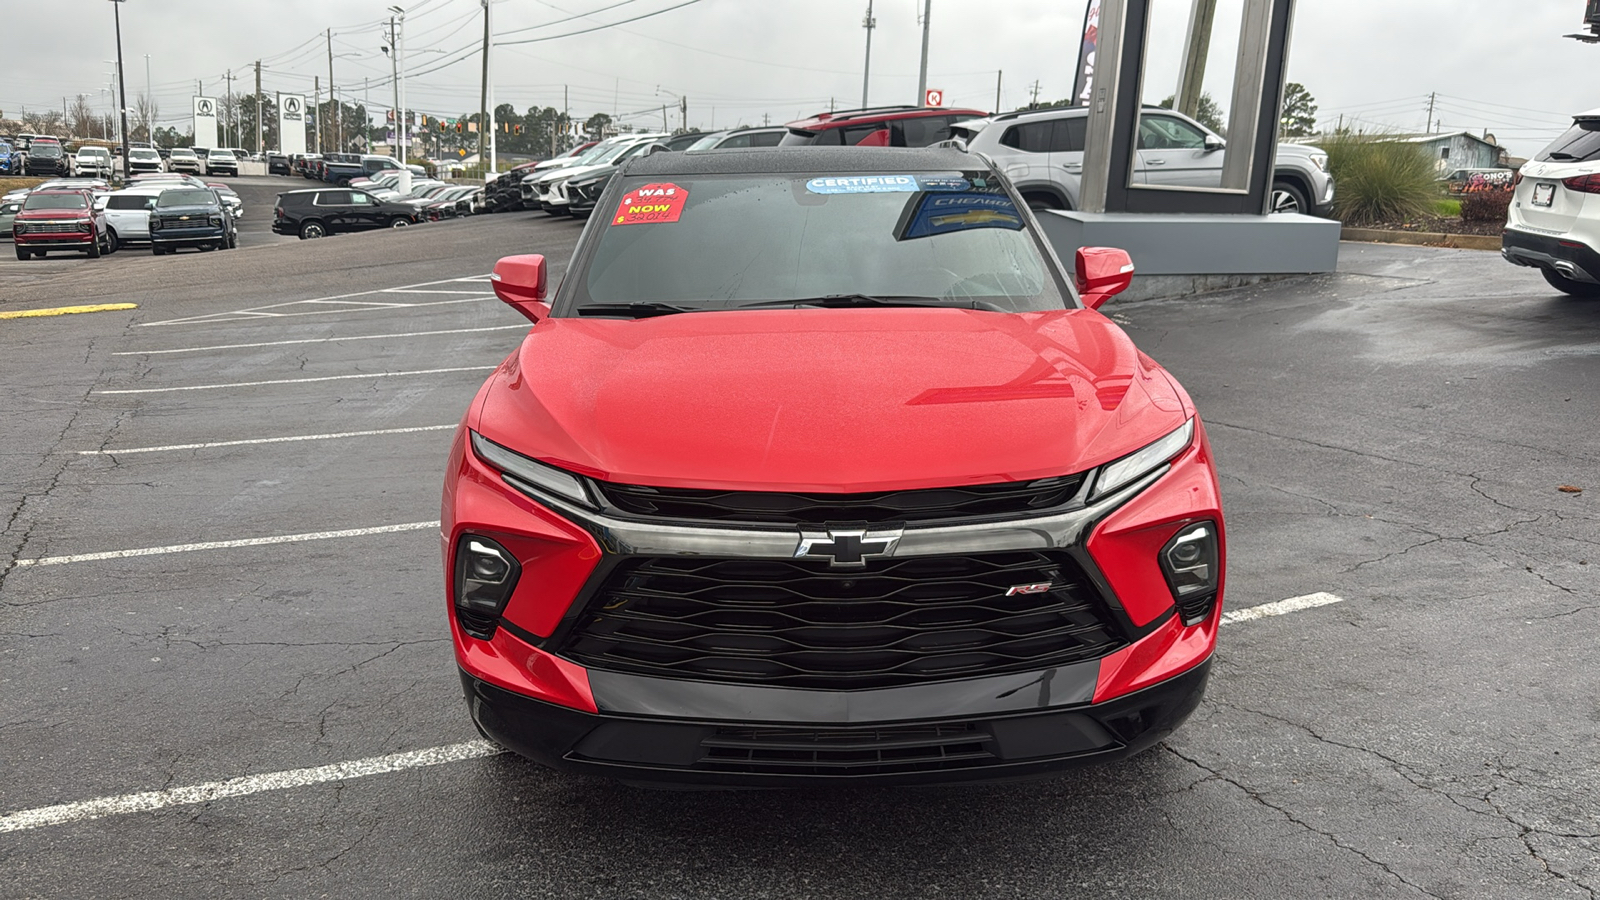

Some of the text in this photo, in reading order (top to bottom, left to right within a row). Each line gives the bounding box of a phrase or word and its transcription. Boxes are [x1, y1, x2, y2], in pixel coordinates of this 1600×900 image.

[811, 177, 910, 187] CERTIFIED
[639, 188, 675, 196] WAS
[629, 204, 670, 213] NOW
[1005, 582, 1053, 597] RS
